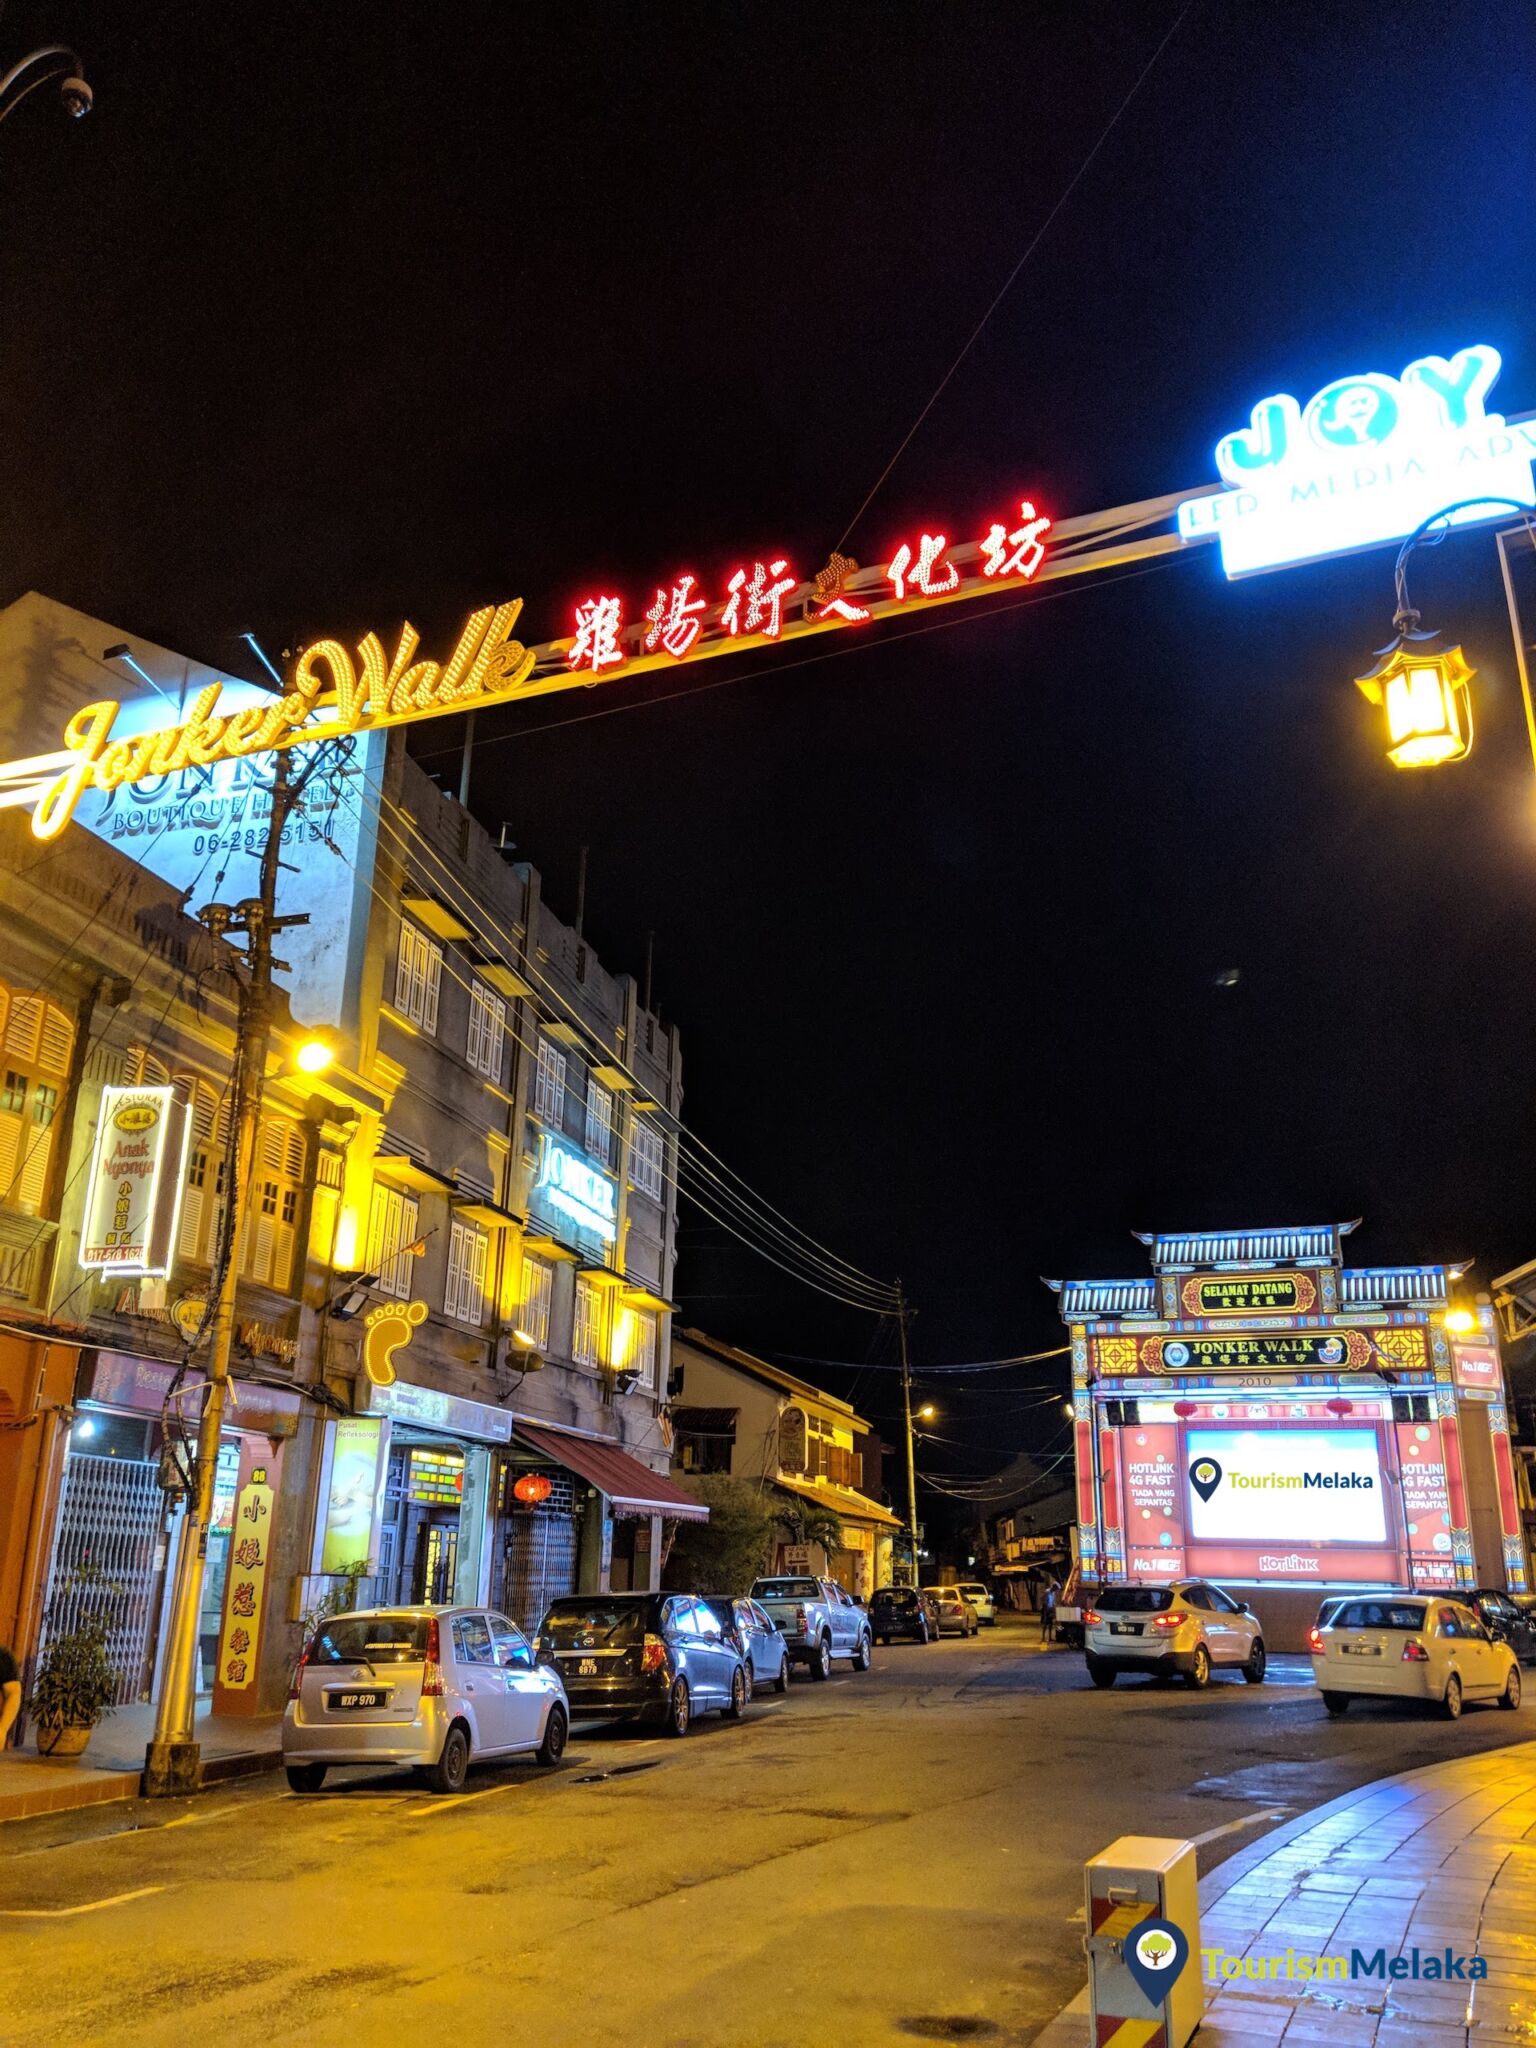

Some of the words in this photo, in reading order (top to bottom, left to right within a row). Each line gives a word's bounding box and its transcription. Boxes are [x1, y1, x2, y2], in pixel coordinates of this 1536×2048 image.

[1216, 345, 1502, 482] JOY
[31, 681, 310, 841] Jonker
[296, 597, 536, 730] Walk
[113, 796, 243, 831] BOUTIQUE
[252, 784, 338, 811] HEL
[115, 1139, 150, 1158] Anak
[103, 1160, 155, 1180] Nyonya
[1204, 1285, 1249, 1297] SELAMAT
[1252, 1282, 1293, 1295] DATANG
[1193, 1341, 1260, 1355] JONKER
[1264, 1339, 1315, 1352] WALK
[1238, 1376, 1272, 1387] 2010
[338, 1421, 358, 1430] Pusat
[1129, 1463, 1175, 1474] HOTLINK
[1401, 1463, 1444, 1475] HOTLIN
[1129, 1475, 1143, 1486] 4G
[1131, 1489, 1154, 1497] TIADA
[1155, 1489, 1175, 1497] YANG
[1134, 1498, 1173, 1507] SEPANTAS
[359, 1694, 376, 1705] 970
